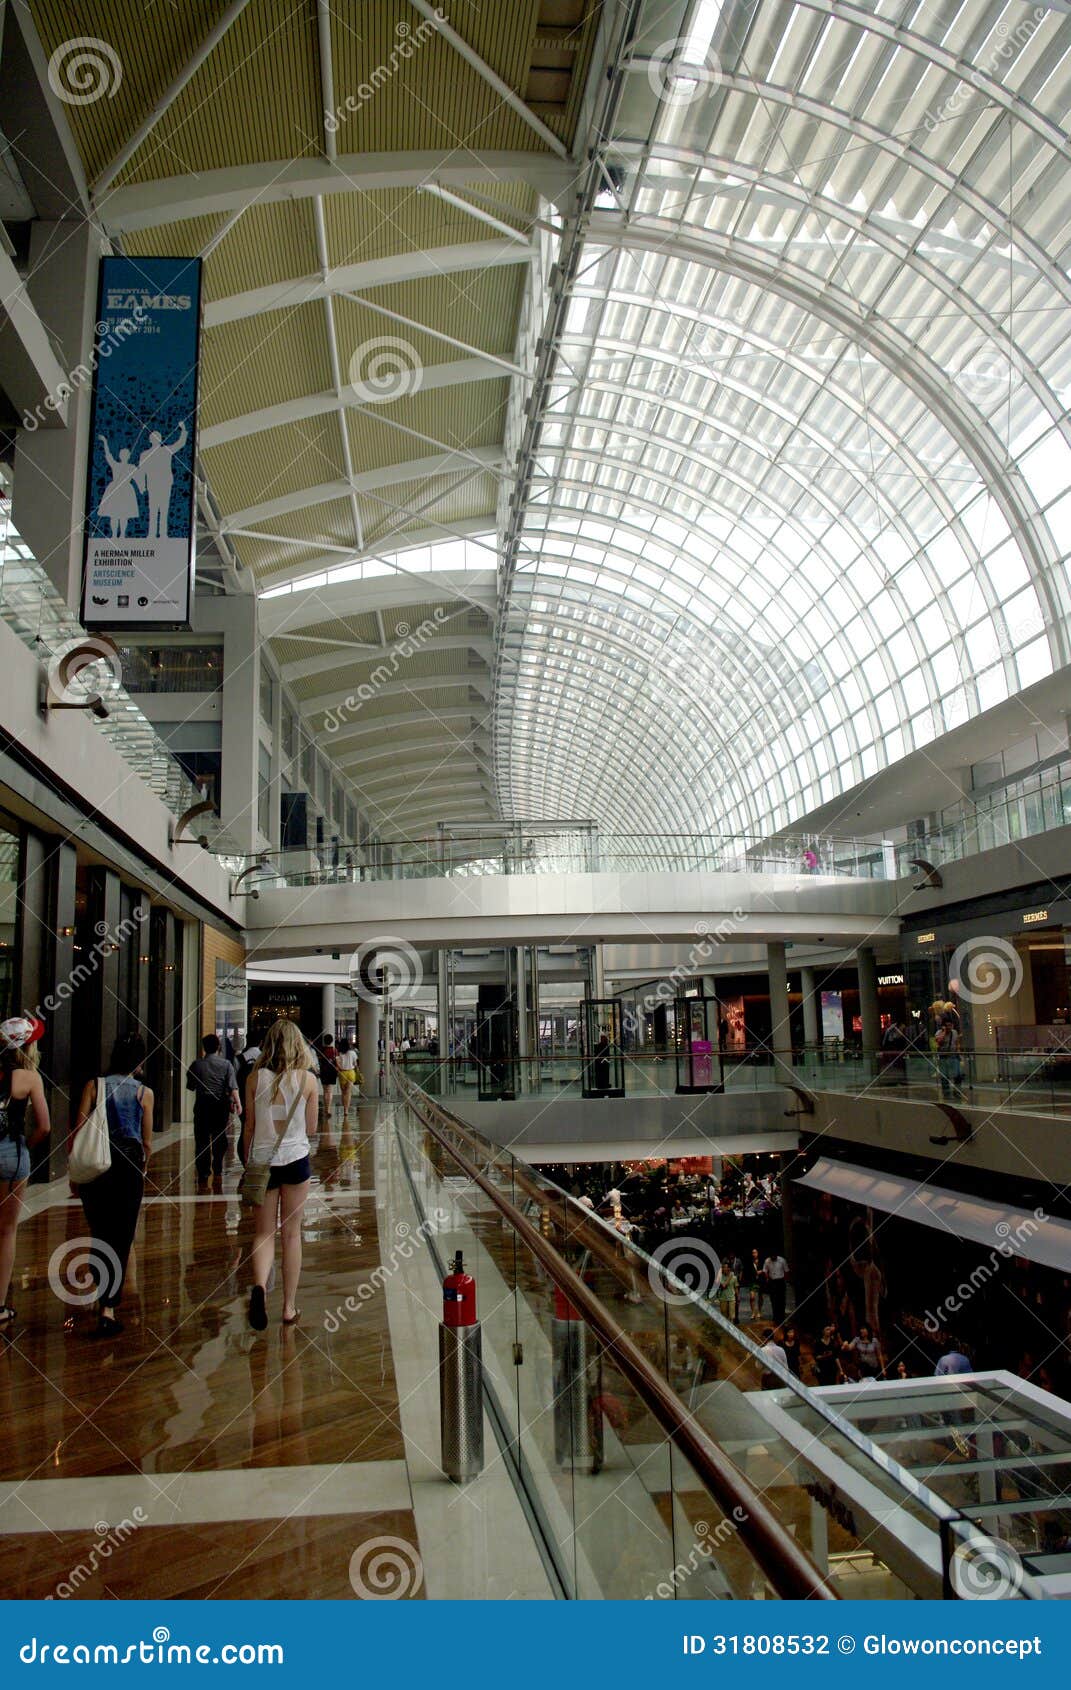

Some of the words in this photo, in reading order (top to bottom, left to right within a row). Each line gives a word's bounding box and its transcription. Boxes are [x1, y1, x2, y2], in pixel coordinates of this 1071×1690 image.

[106, 295, 192, 310] EAMES
[94, 549, 99, 557] A
[101, 549, 129, 558] HERMAN
[130, 549, 155, 558] MILLER
[94, 559, 133, 567] EXHIBITION
[93, 569, 135, 578] ARTSCIENCE
[92, 579, 123, 587] MUSEUM
[877, 975, 904, 985] VUITTON
